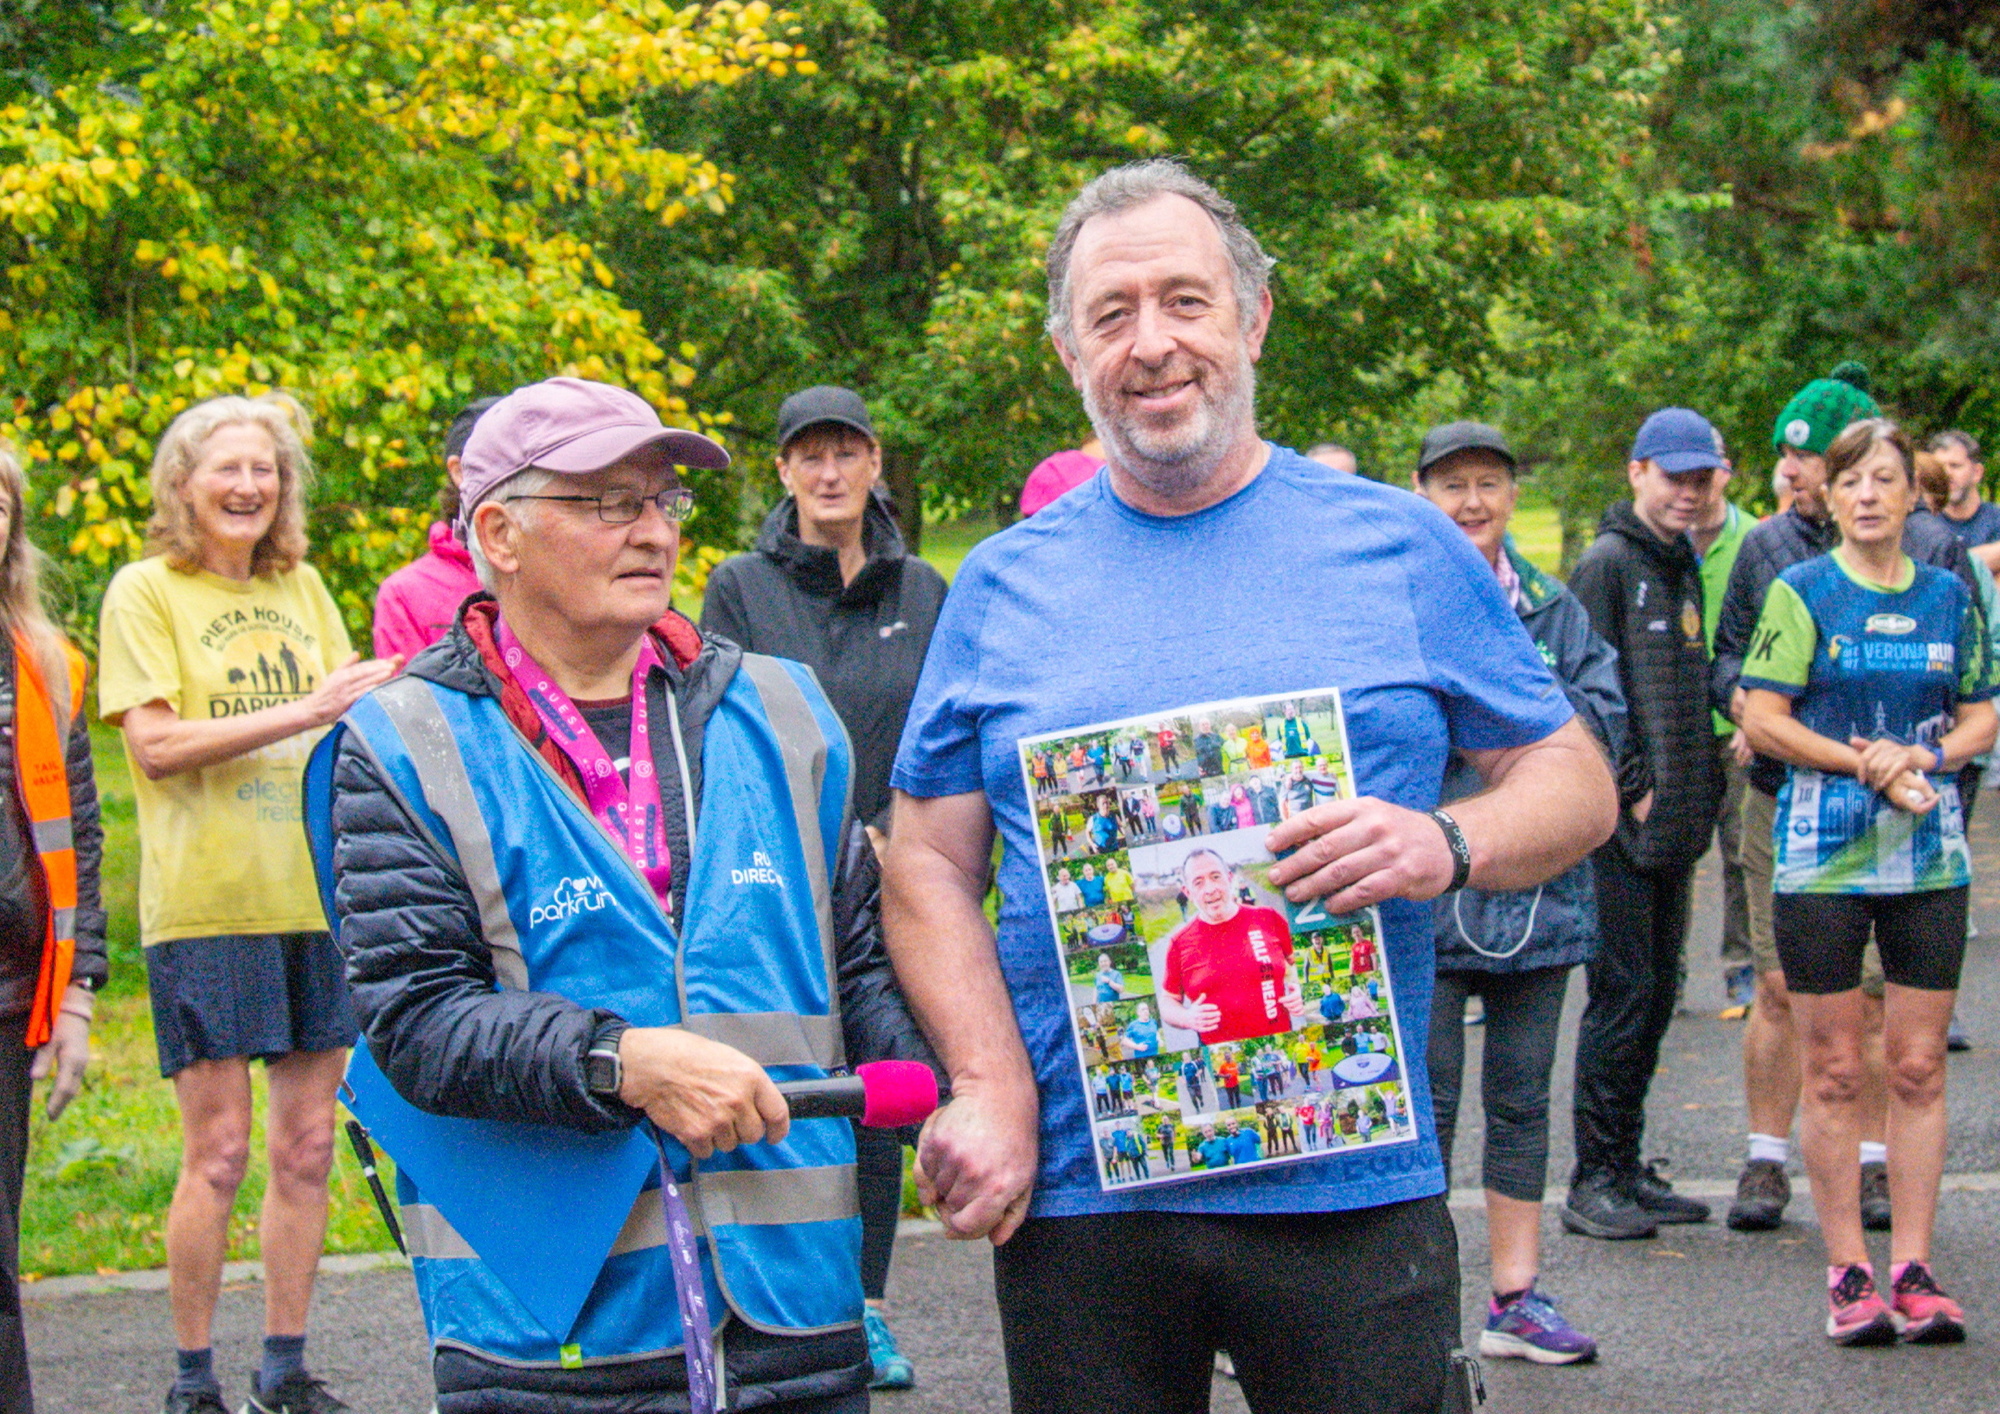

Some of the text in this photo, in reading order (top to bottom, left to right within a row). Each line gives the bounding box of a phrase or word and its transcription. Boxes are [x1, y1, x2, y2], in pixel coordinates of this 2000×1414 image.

[200, 609, 248, 648] PIETA
[253, 606, 317, 645] HOUSE
[537, 680, 586, 735] QUEST
[634, 803, 647, 869] QUEST
[752, 850, 772, 867] RU
[529, 890, 618, 930] parkrun
[1247, 930, 1272, 964] HALF
[1260, 979, 1278, 1019] HEAD
